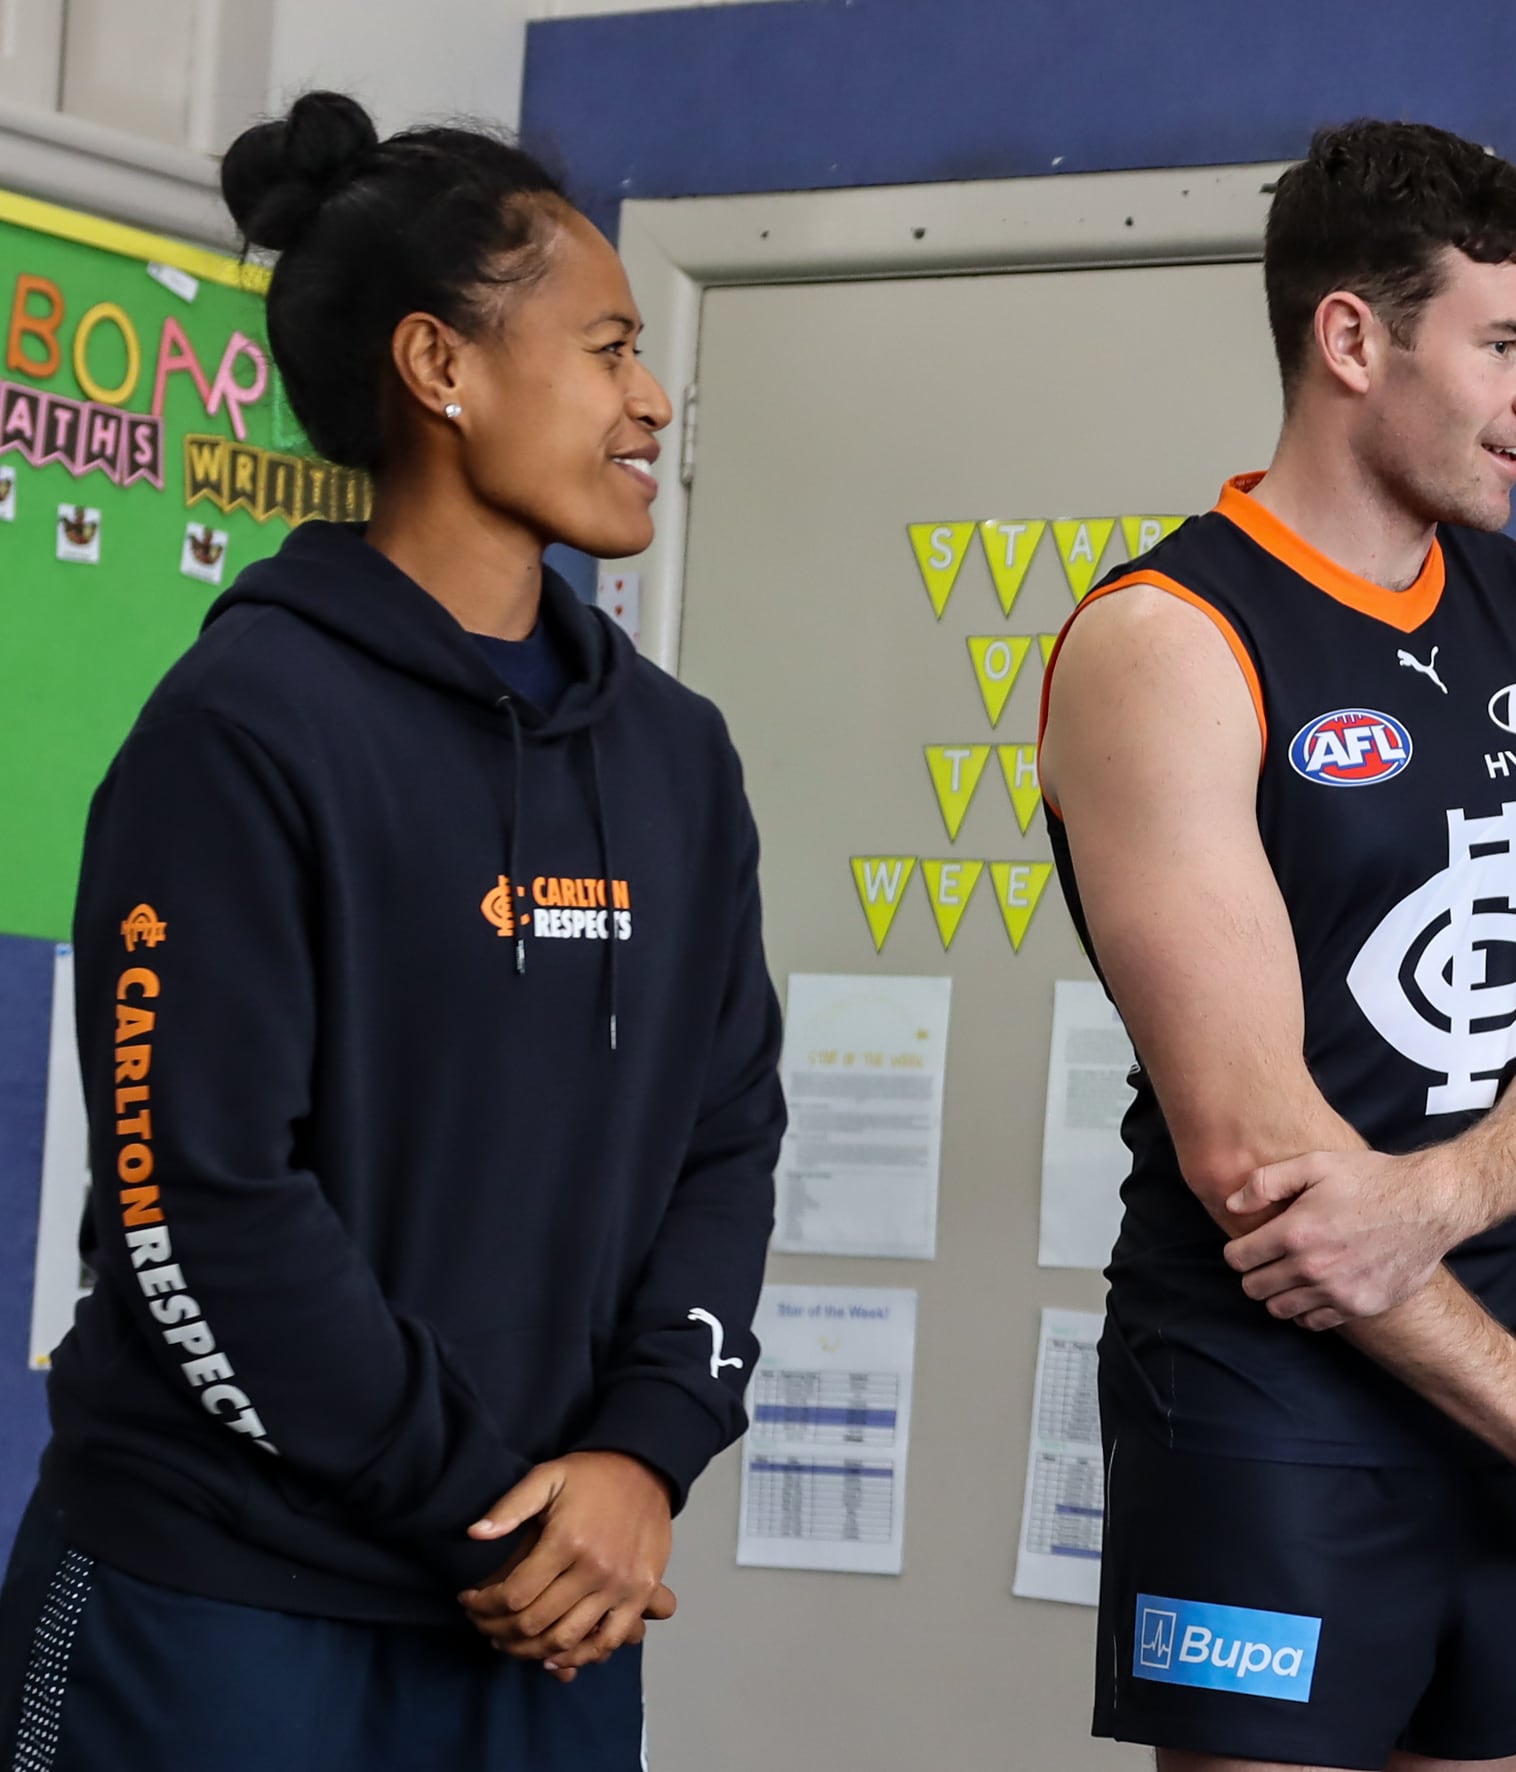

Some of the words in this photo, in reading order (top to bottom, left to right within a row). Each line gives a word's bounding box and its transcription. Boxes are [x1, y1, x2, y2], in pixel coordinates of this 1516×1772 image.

[7, 273, 308, 450] BOAR
[1306, 726, 1406, 772] AFL
[1179, 1625, 1303, 1678] Bupa
